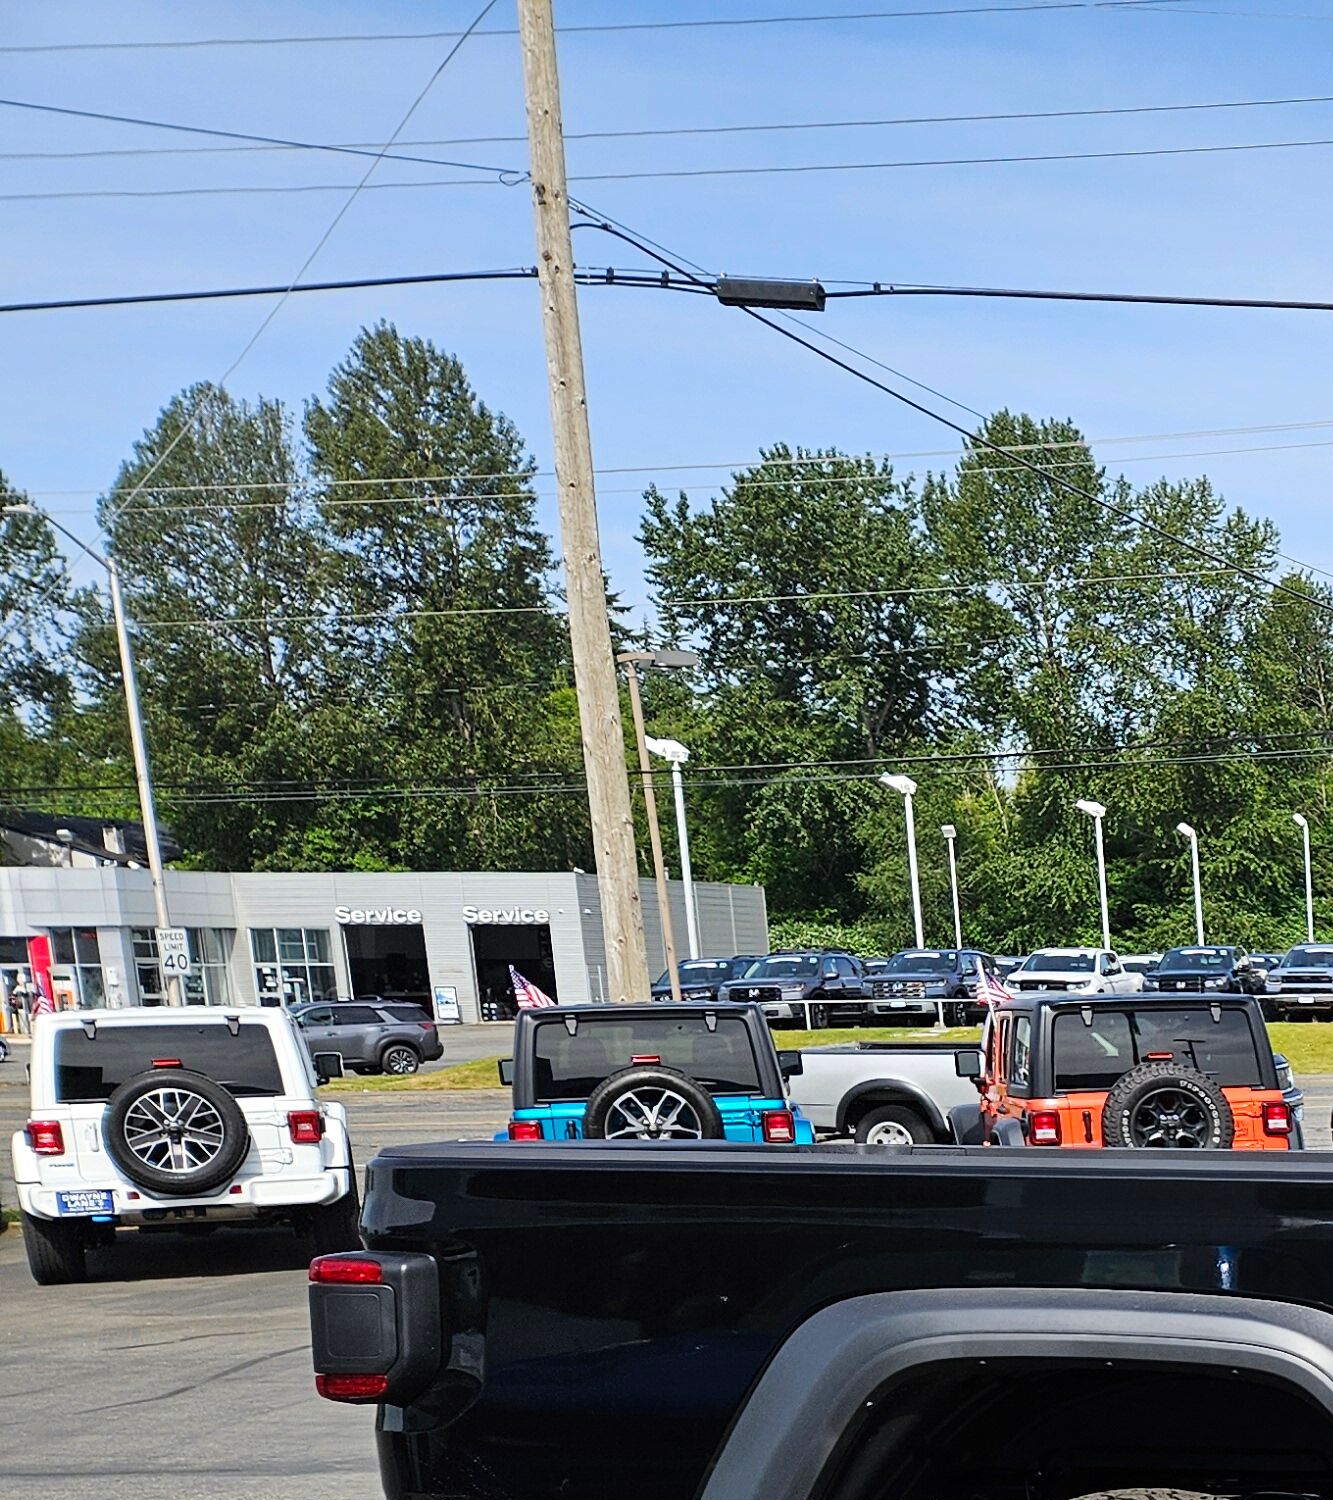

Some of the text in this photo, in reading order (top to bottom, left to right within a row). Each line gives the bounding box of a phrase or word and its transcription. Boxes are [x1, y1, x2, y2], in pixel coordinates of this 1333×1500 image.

[335, 905, 422, 923] Service
[462, 905, 550, 923] Service
[159, 932, 184, 941] SPEED
[164, 943, 183, 951] LIMIT
[164, 953, 188, 970] 40
[61, 1191, 108, 1201] DWAYNE
